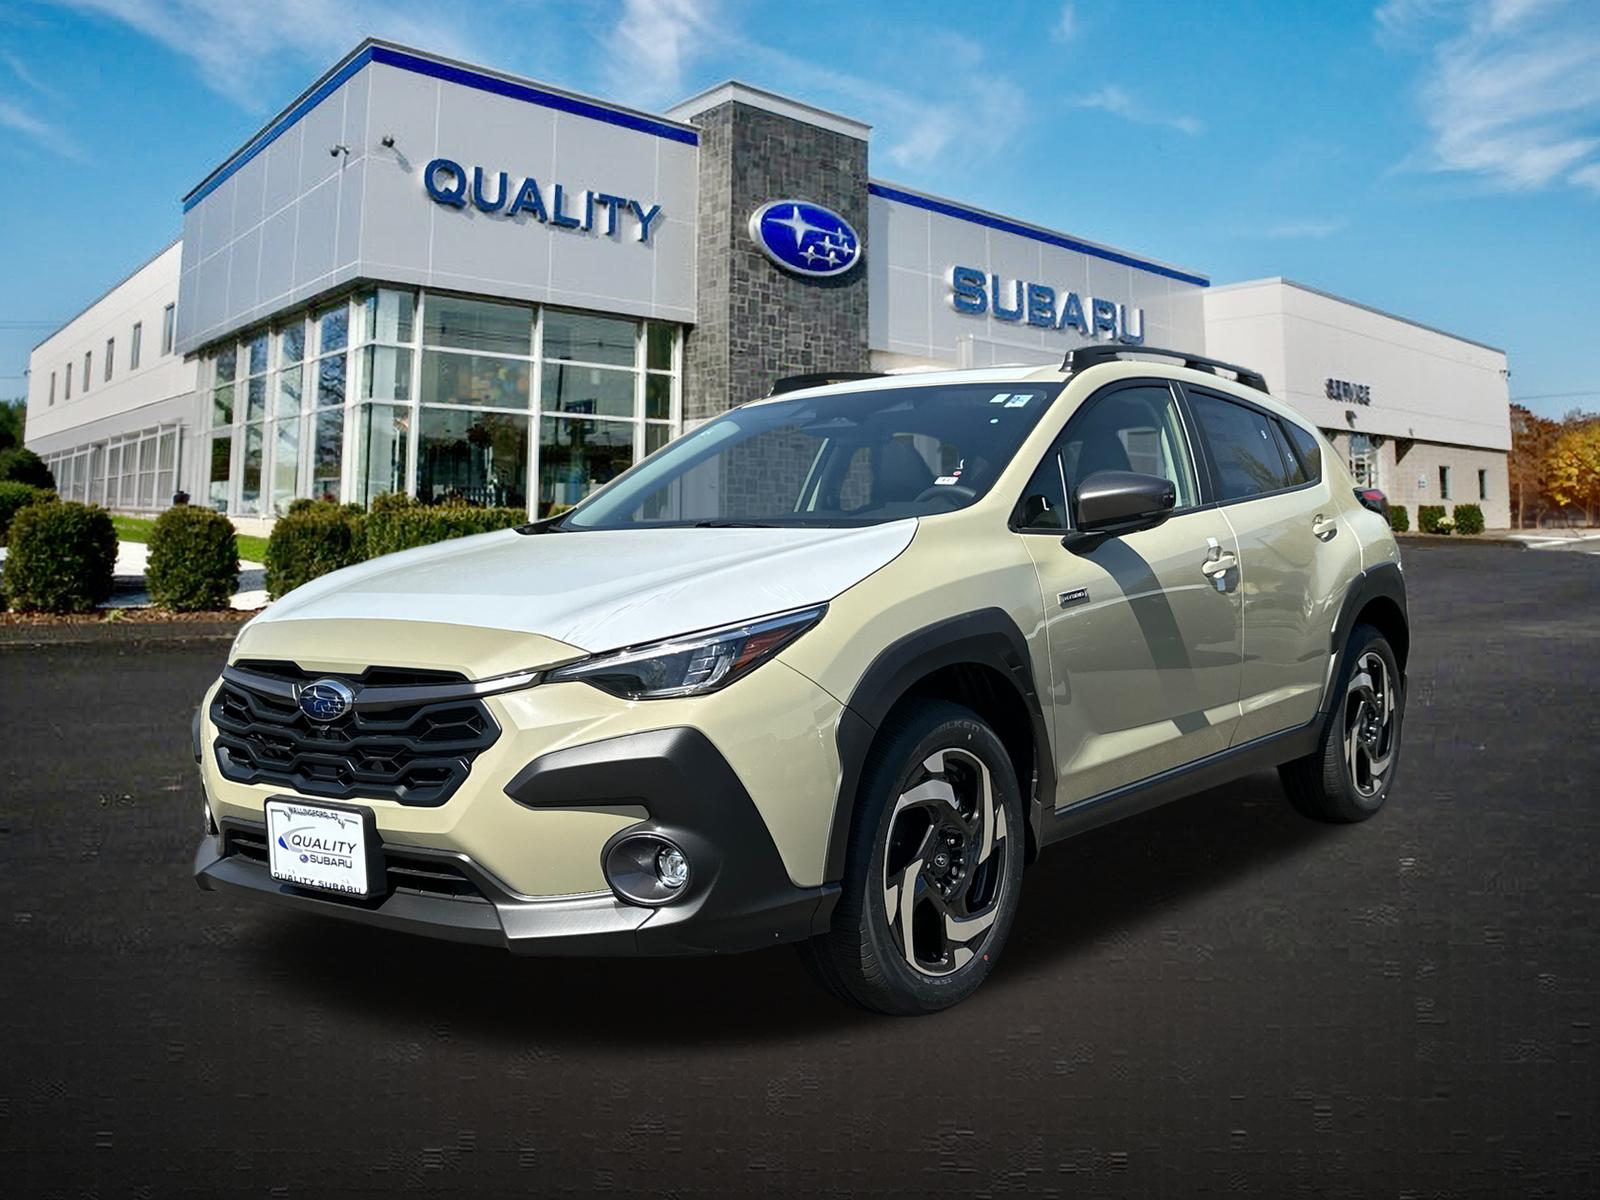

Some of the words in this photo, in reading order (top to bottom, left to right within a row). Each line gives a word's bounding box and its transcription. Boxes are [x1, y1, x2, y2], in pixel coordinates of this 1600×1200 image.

[424, 158, 661, 243] QUALITY
[947, 266, 1144, 346] SUBARU
[1326, 378, 1371, 406] SERVICE
[291, 834, 357, 854] QUALITY
[309, 854, 353, 869] SUBARU
[273, 872, 315, 886] QUALITY
[318, 880, 361, 894] SUBARU
